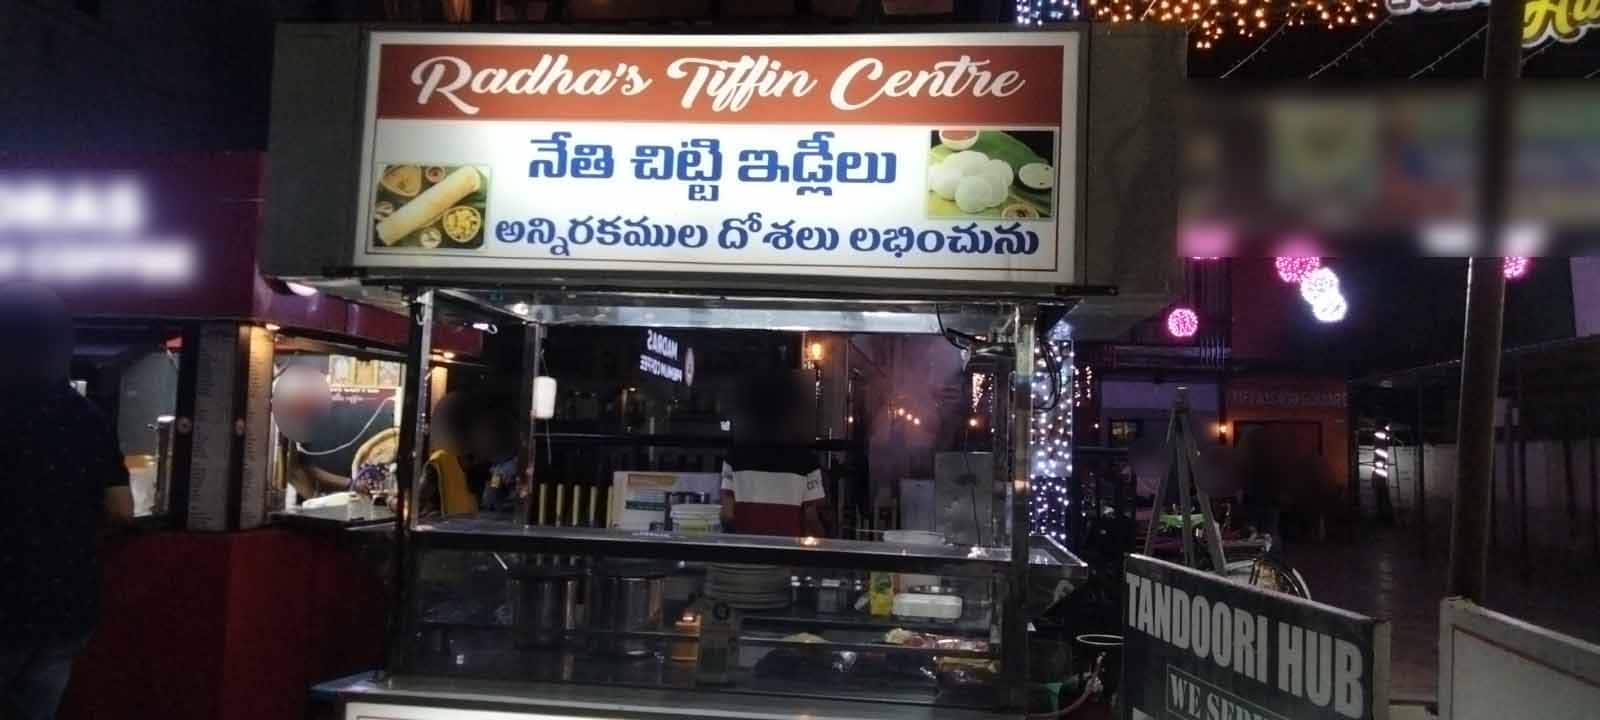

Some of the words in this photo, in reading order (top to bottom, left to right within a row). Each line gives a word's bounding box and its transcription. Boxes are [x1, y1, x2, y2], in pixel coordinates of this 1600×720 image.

[411, 54, 651, 114] Radha's
[667, 55, 818, 112] Tiffin
[830, 54, 1026, 111] Centre
[528, 131, 615, 179] నేతి
[630, 138, 723, 202] చిట్టి
[738, 131, 897, 196] ఇడ్లీలు
[494, 215, 709, 257] అన్నిరకముల
[718, 212, 840, 251] దోశలు
[849, 222, 1039, 258] లభించును
[1126, 571, 1268, 684] TANDOORI
[1278, 621, 1364, 720] HUB
[1170, 672, 1201, 719] WE
